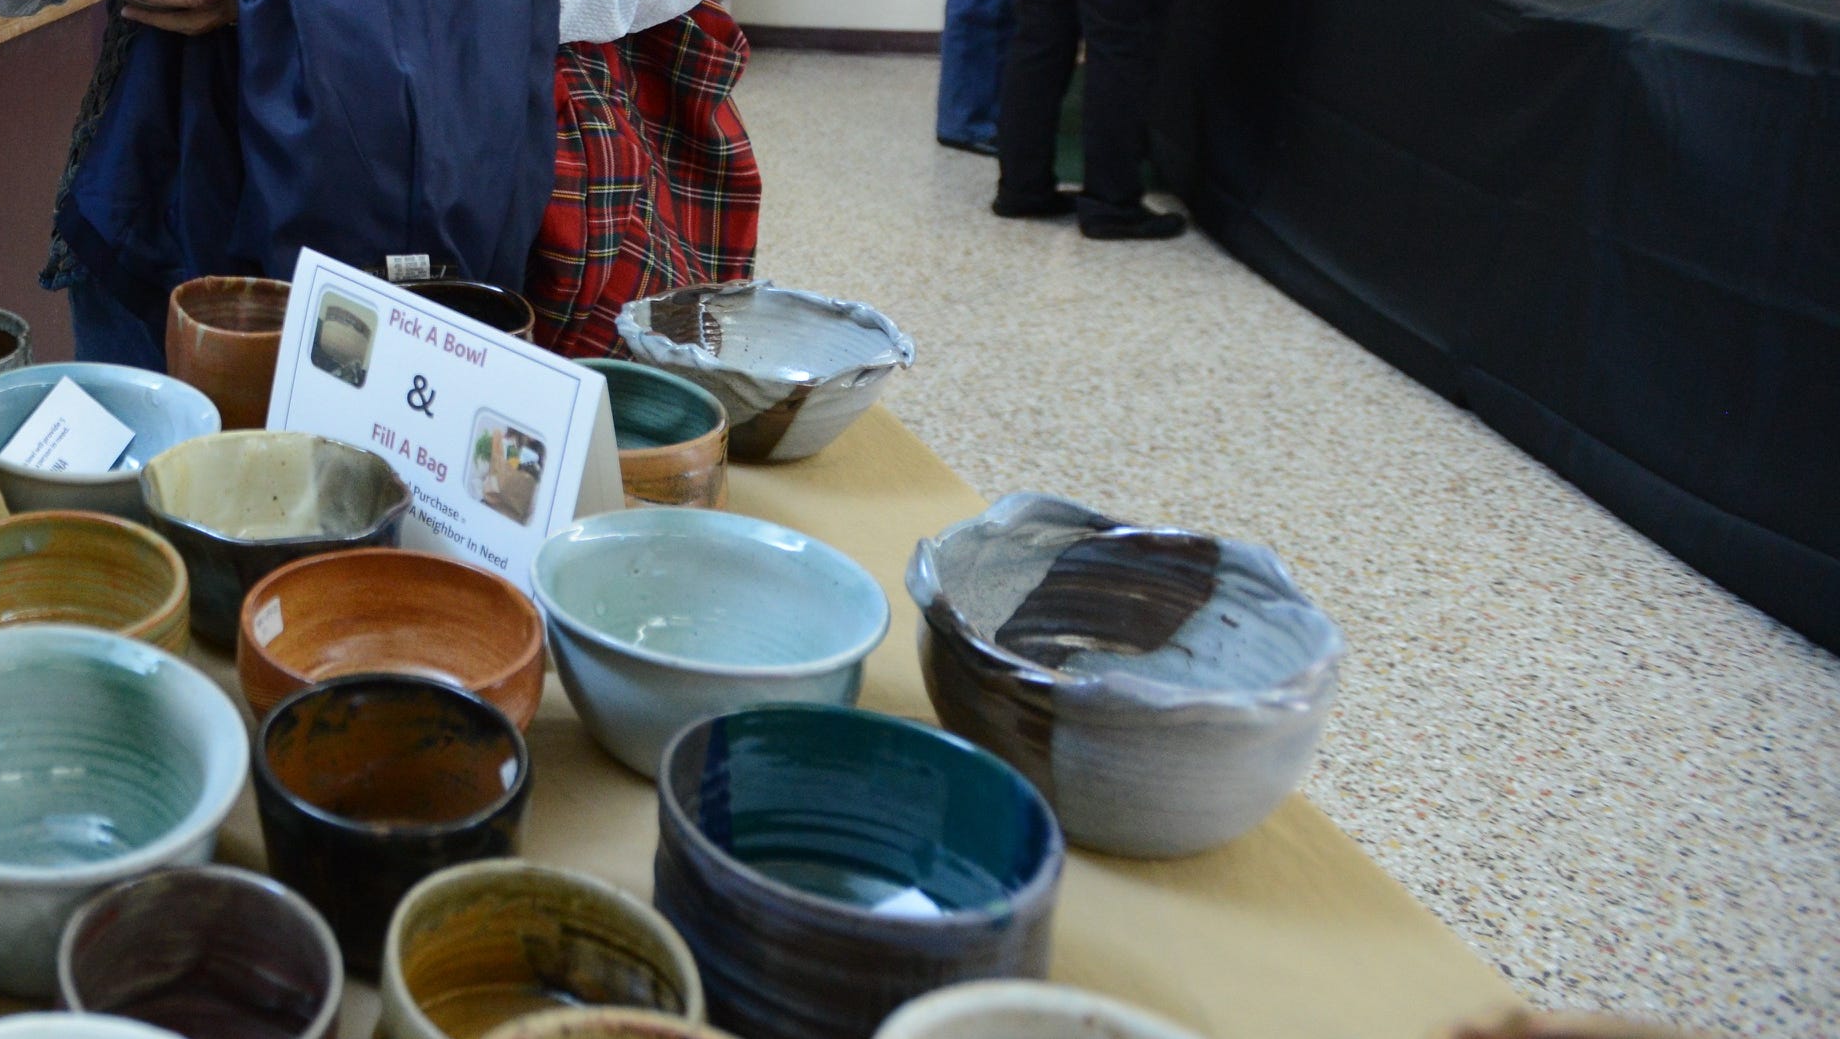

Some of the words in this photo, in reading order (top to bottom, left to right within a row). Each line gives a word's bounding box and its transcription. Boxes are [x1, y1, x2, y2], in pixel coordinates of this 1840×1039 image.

[389, 308, 422, 339] Pick
[425, 325, 438, 347] A
[443, 332, 488, 368] Bowl
[406, 374, 436, 419] &
[371, 423, 396, 450] Fill
[398, 438, 411, 459] A
[416, 446, 449, 482] Bag
[412, 485, 460, 522] Purchase
[408, 505, 417, 519] A
[418, 511, 466, 545] Neighbor
[466, 537, 479, 553] In
[479, 545, 510, 571] Need
